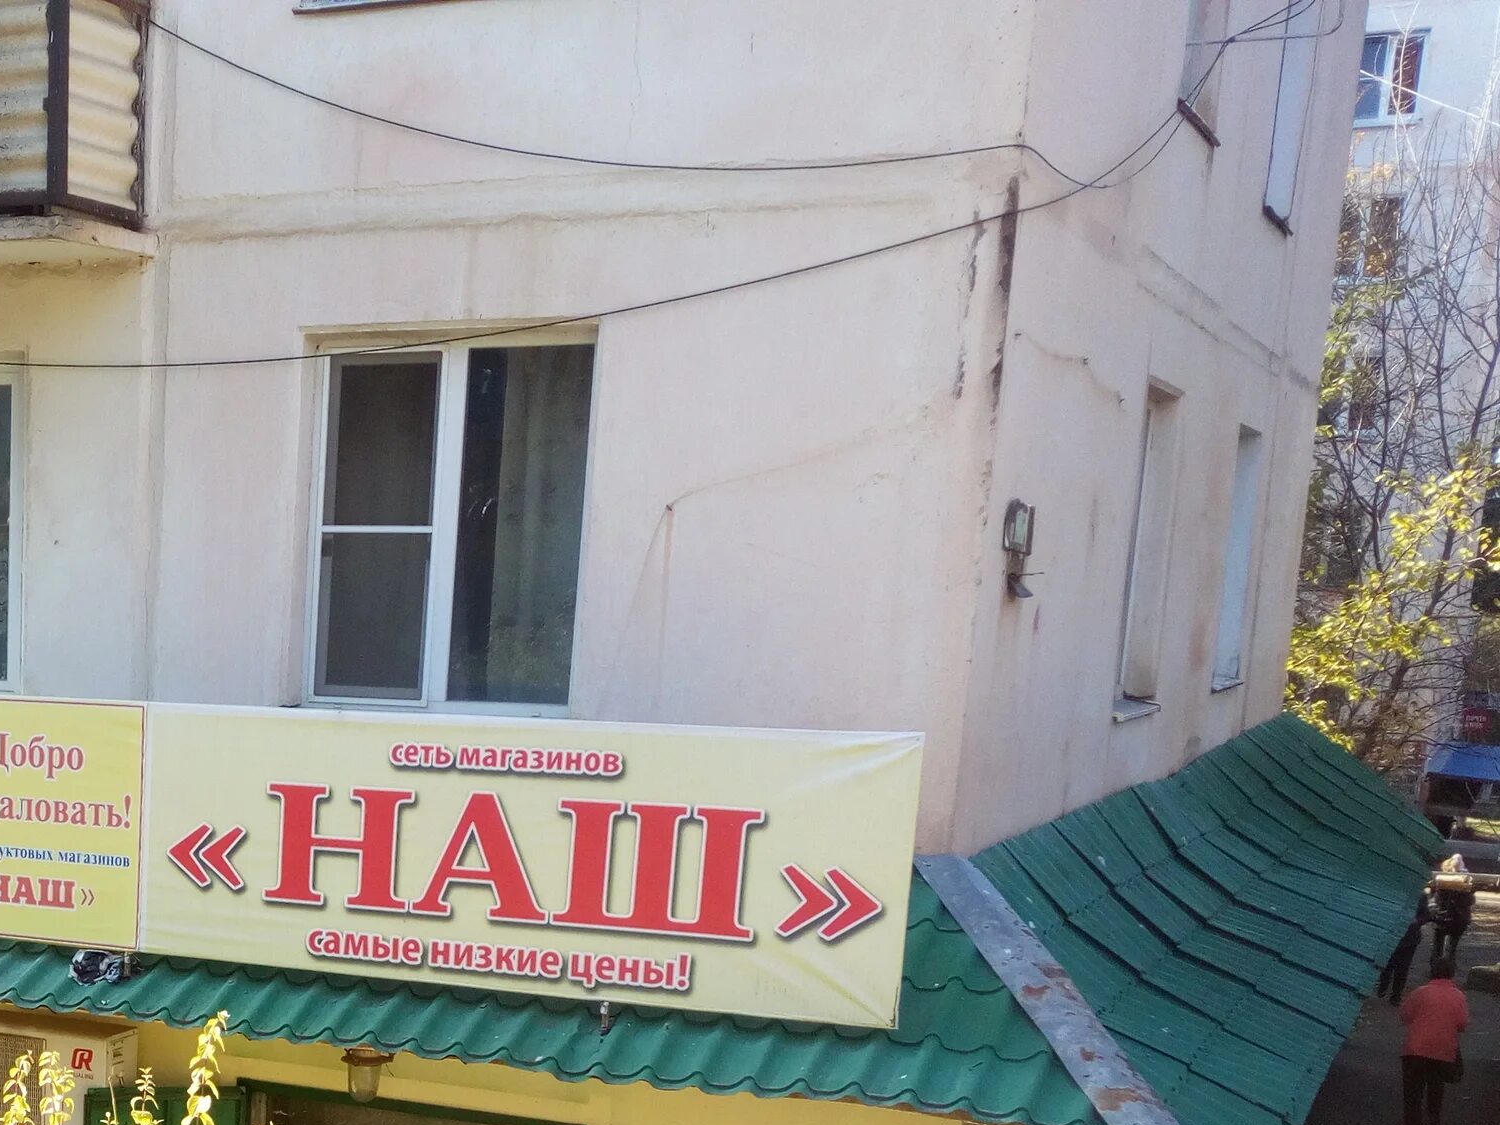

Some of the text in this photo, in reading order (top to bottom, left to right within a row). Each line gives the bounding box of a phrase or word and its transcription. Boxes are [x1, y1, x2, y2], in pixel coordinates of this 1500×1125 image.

[390, 743, 624, 777] сеть магазинов
[57, 852, 131, 869] магазинов
[306, 927, 693, 993] самые низкие цены!
